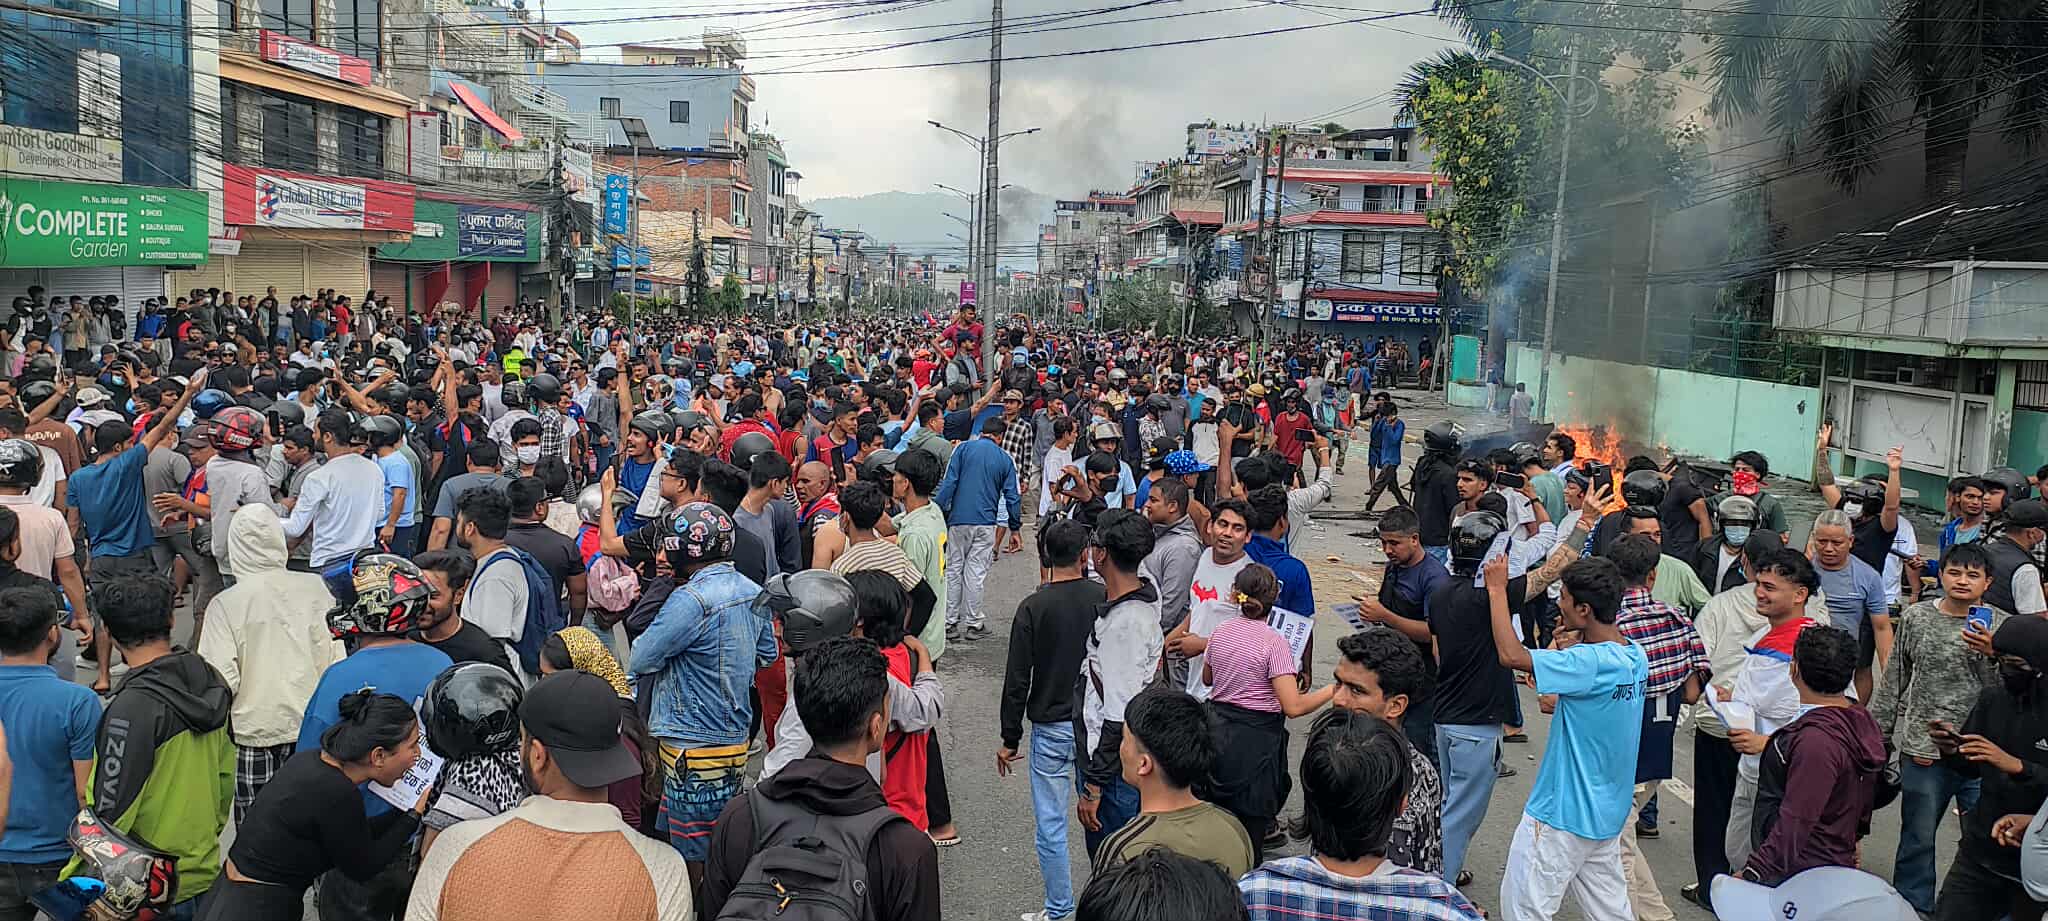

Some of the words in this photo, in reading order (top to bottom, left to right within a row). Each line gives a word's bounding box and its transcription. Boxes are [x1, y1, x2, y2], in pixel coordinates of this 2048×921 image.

[45, 132, 97, 155] Goodwill
[19, 151, 65, 169] Developers
[280, 186, 313, 205] Global
[317, 188, 337, 206] IME
[340, 191, 363, 207] Bank
[223, 226, 239, 239] TM
[493, 235, 522, 247] Furniture
[70, 237, 128, 258] Garden
